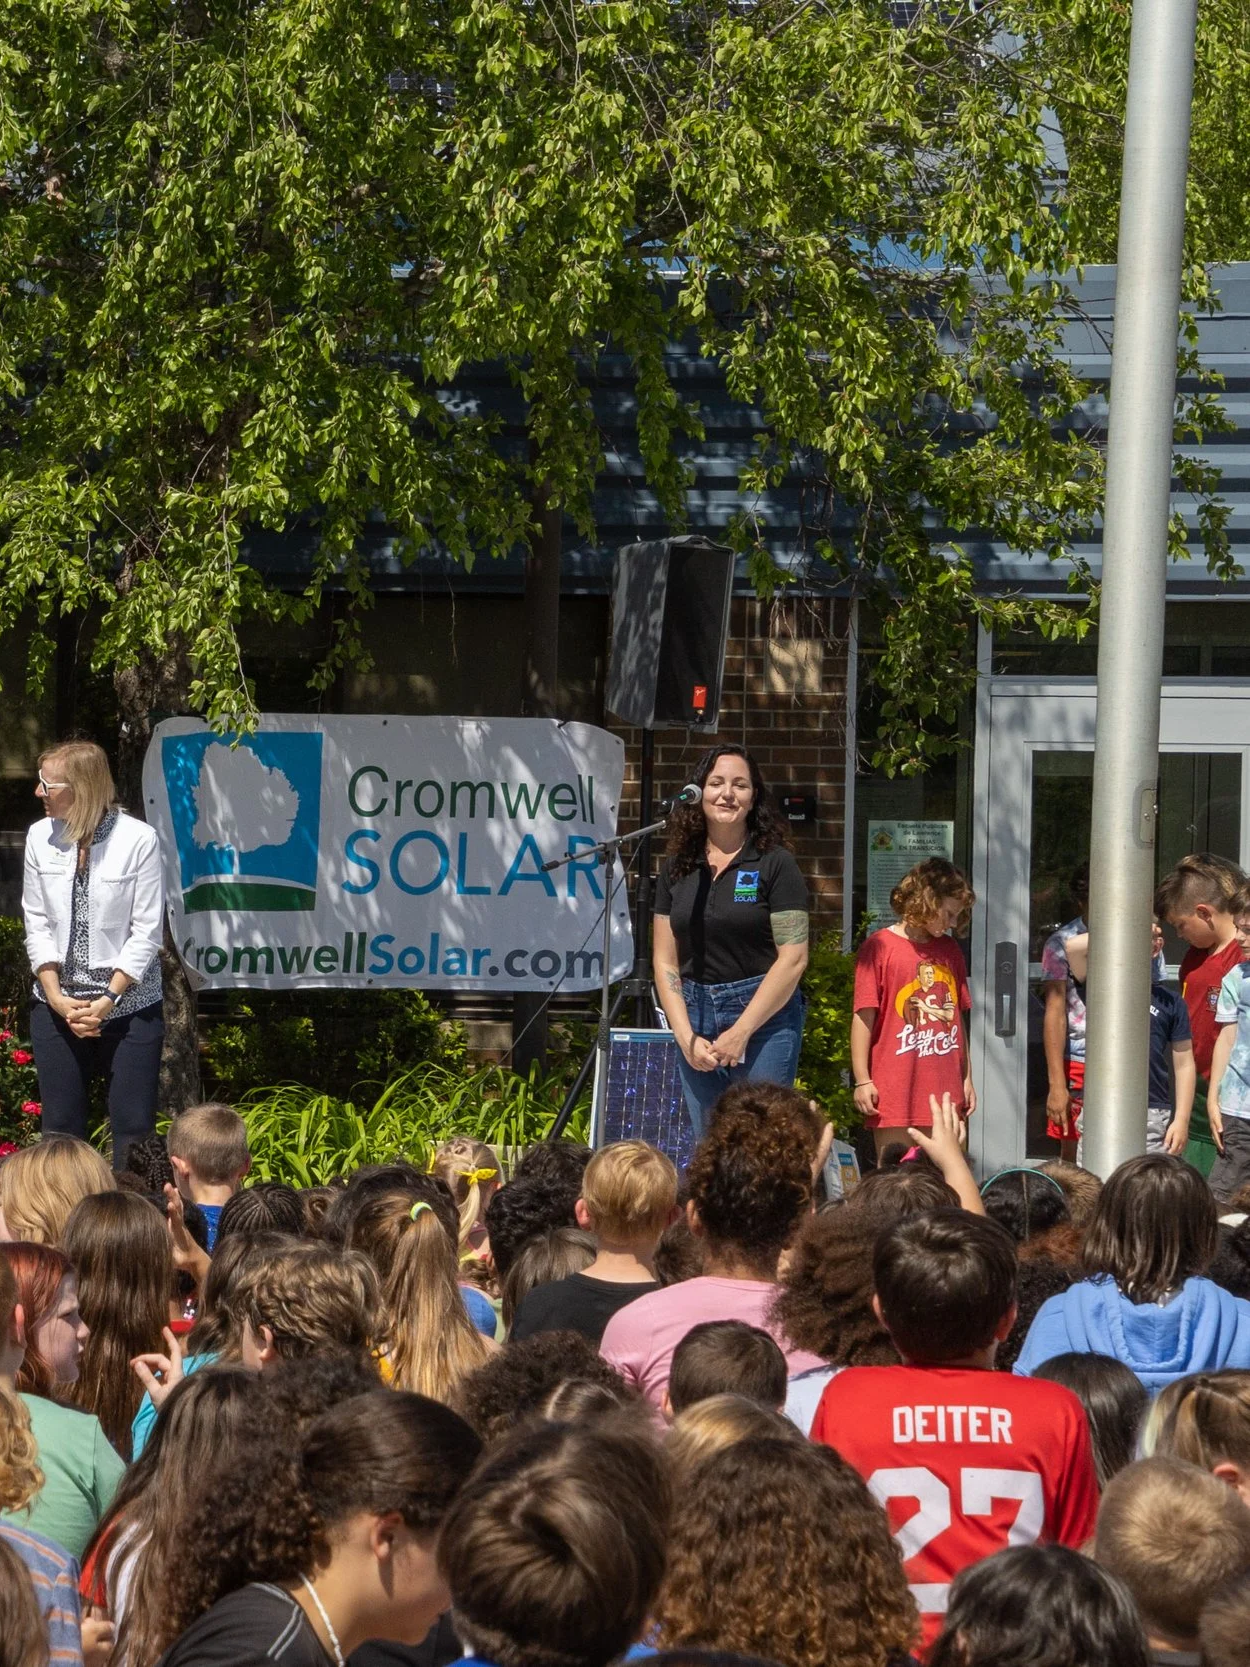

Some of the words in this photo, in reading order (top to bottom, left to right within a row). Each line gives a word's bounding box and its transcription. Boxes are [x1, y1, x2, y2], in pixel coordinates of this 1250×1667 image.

[348, 765, 594, 824] Cromwell
[341, 830, 604, 900] SOLAR
[892, 1405, 1013, 1444] DEITER
[867, 1467, 1044, 1613] 27
